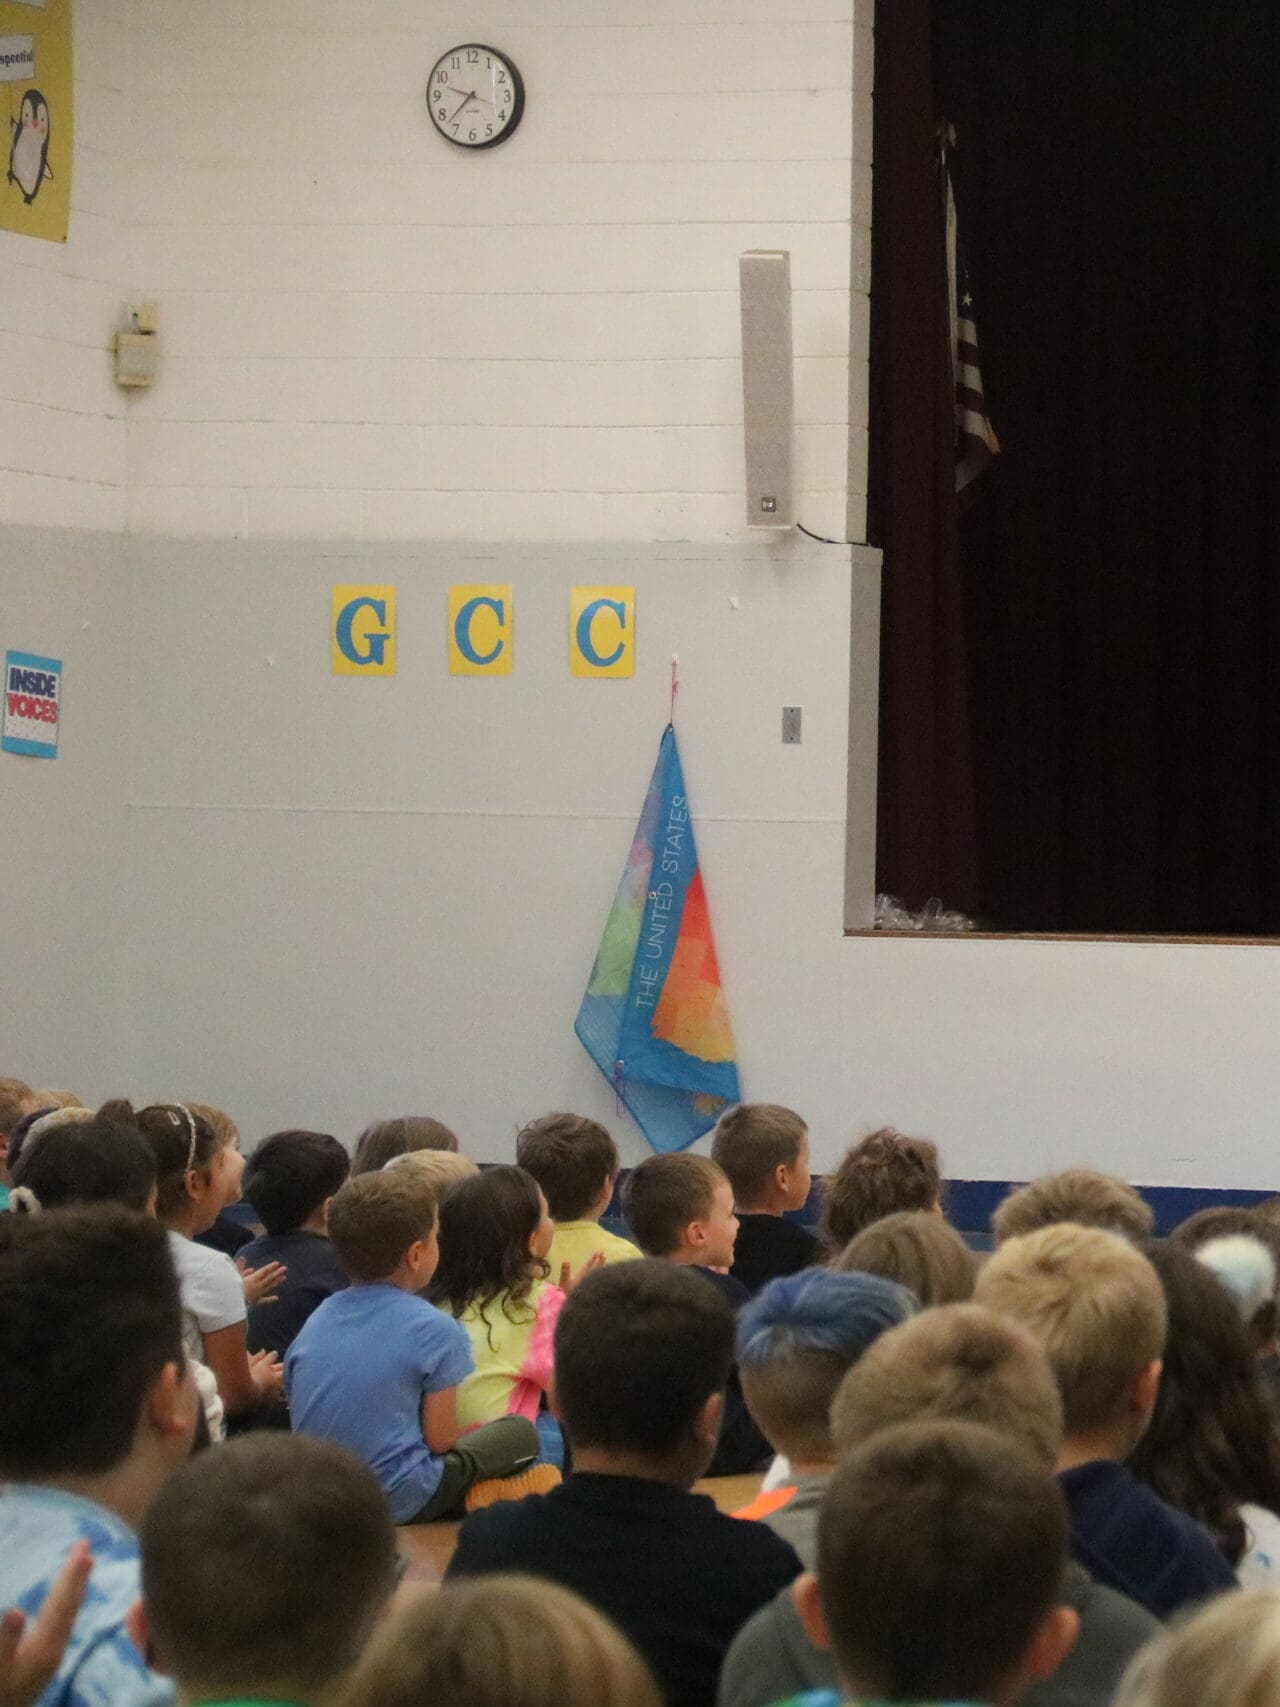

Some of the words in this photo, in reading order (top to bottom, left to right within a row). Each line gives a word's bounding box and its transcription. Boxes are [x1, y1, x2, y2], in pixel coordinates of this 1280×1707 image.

[466, 50, 479, 63] 12
[486, 57, 491, 69] 1
[451, 57, 460, 70] 11
[437, 70, 448, 83] 10
[497, 70, 506, 84] 2
[433, 89, 442, 103] 9
[503, 89, 511, 103] 3
[438, 108, 446, 121] 8
[498, 109, 506, 121] 4
[452, 123, 460, 136] 7
[468, 128, 477, 141] 6
[485, 123, 493, 136] 5
[336, 597, 390, 665] G
[454, 597, 504, 665] C
[576, 599, 626, 667] C
[9, 667, 56, 698] INSIDE
[7, 692, 58, 724] VOICES
[661, 795, 688, 873] STATES
[645, 882, 673, 959] UNITED
[636, 964, 658, 1008] THE
